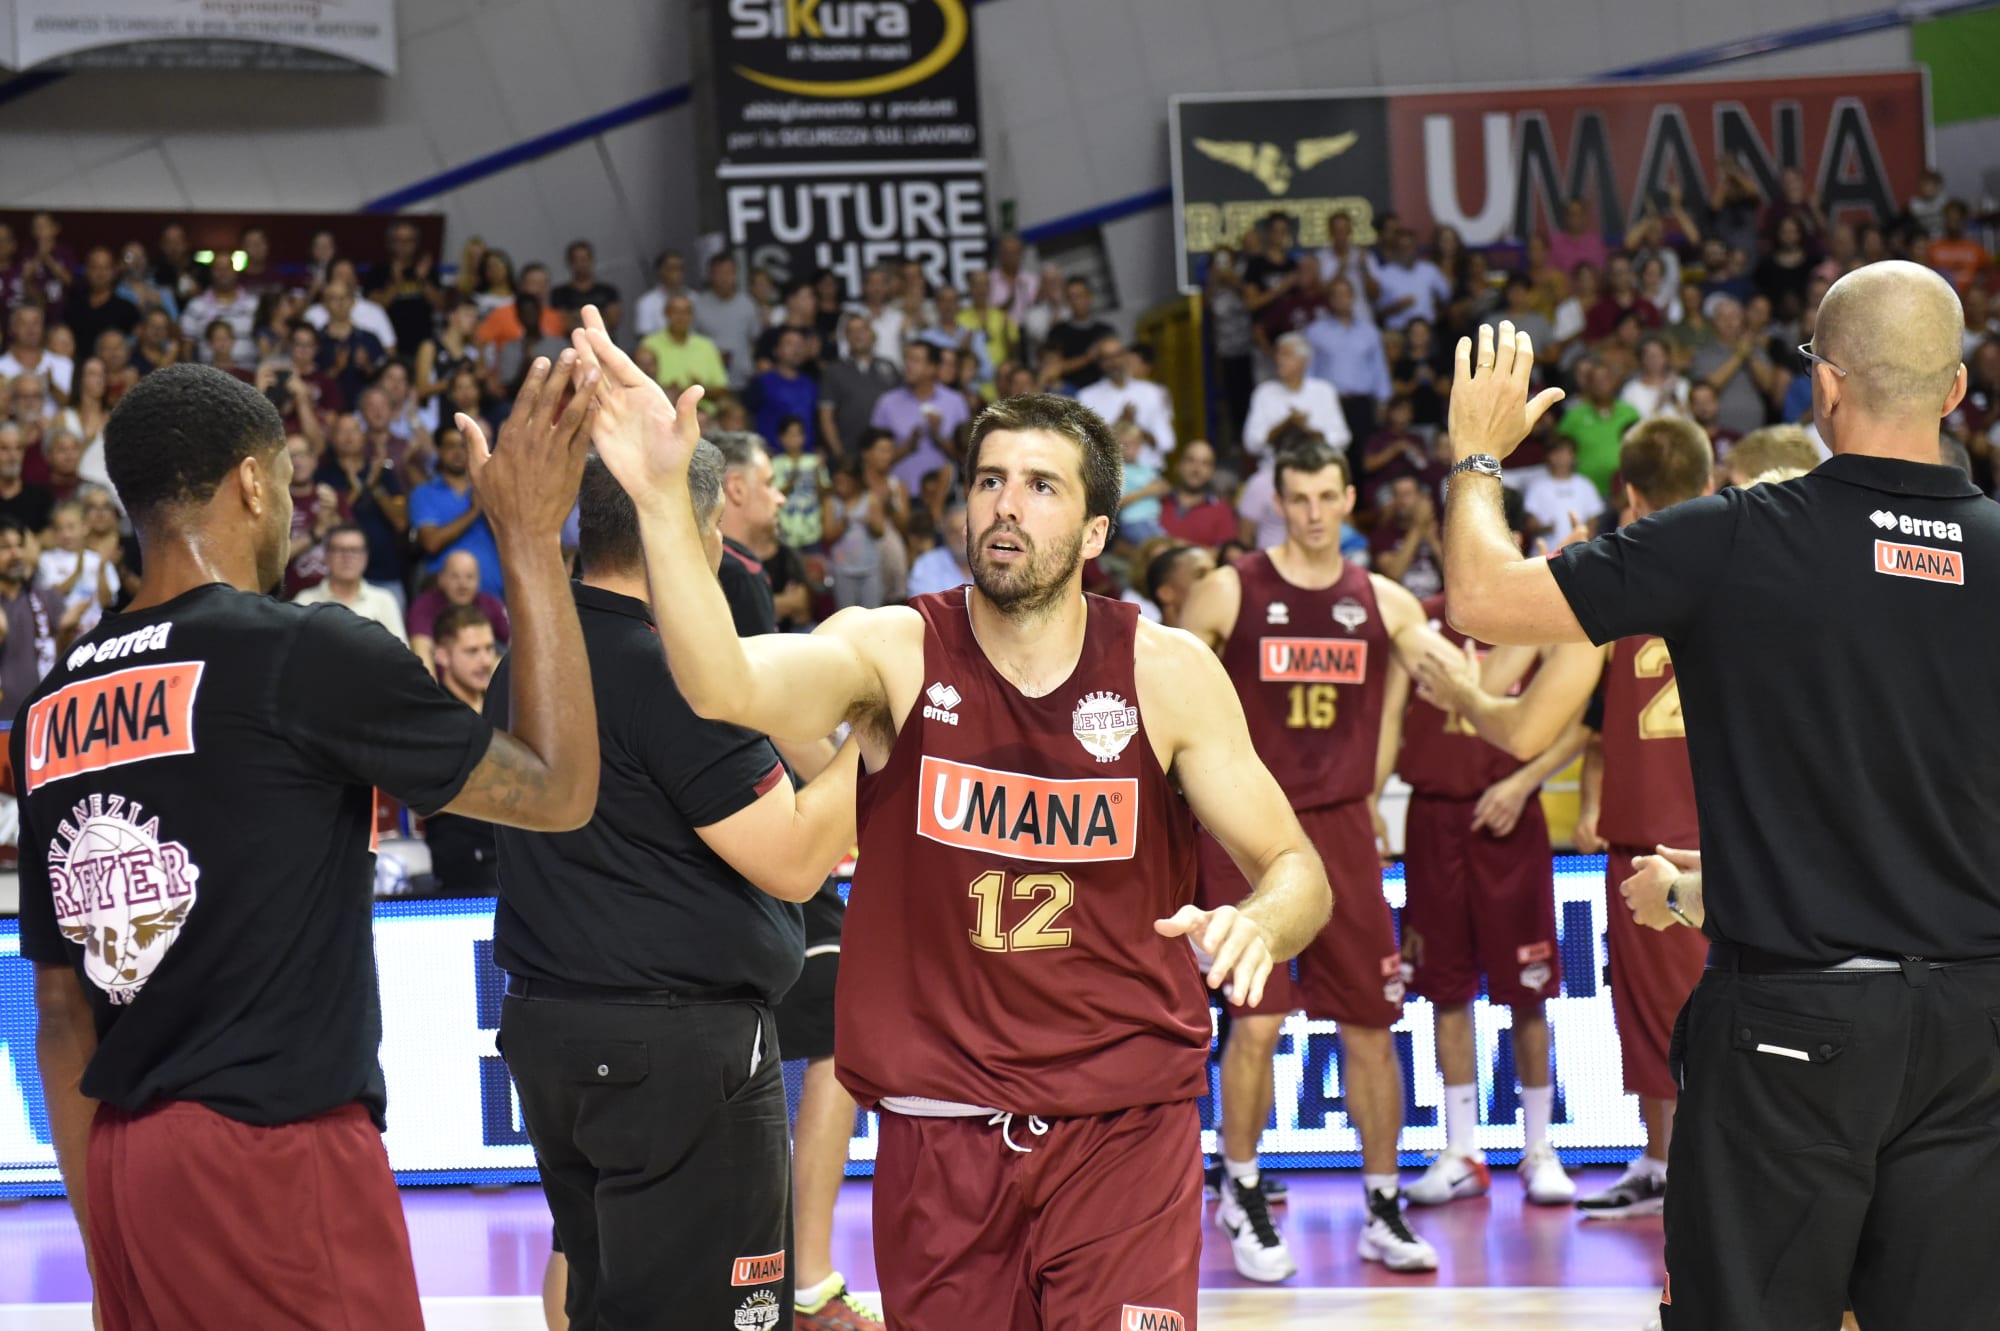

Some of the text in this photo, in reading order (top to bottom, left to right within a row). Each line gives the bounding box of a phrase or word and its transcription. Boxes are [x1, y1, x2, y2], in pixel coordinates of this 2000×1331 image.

[1423, 97, 1898, 246] UMANA
[727, 179, 986, 244] FUTURE
[1899, 514, 1963, 543] errea
[1882, 546, 1955, 578] UMANA
[93, 621, 173, 663] errea
[1268, 643, 1357, 674] UMANA
[922, 704, 959, 726] errea
[1286, 683, 1338, 729] 16
[48, 793, 160, 863] VENEZIA
[968, 870, 1075, 953] 12
